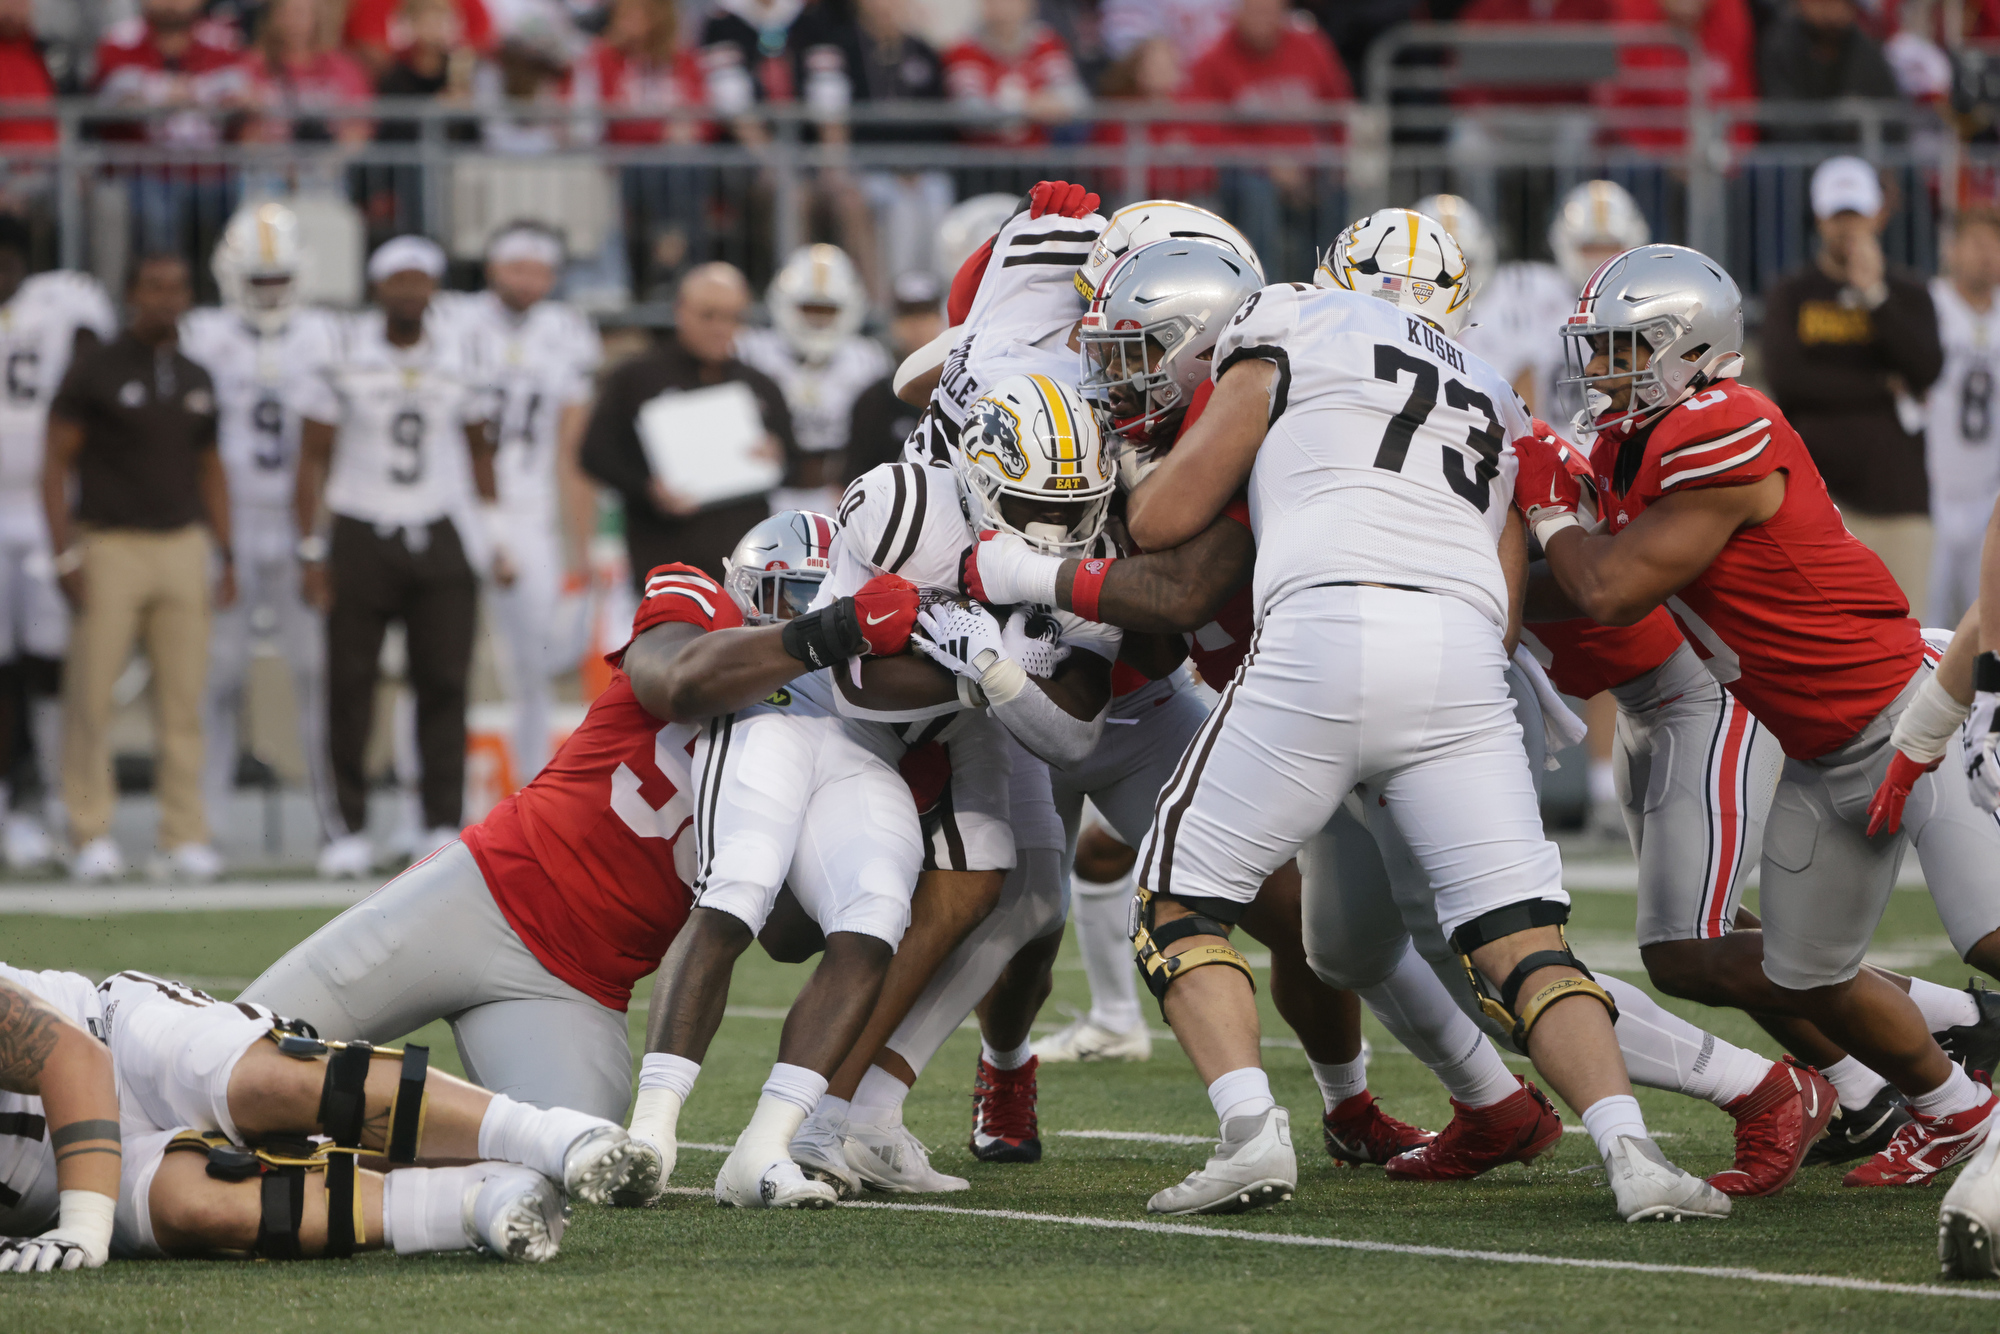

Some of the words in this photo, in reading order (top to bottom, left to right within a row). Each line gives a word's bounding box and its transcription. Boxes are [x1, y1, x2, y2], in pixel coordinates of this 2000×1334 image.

[1413, 288, 1433, 297] MAC
[1406, 317, 1467, 375] KUSHI
[1373, 343, 1506, 515] 73
[1055, 477, 1081, 490] EAT
[806, 557, 824, 569] OHIO
[1940, 1141, 1969, 1166] ALPHA
